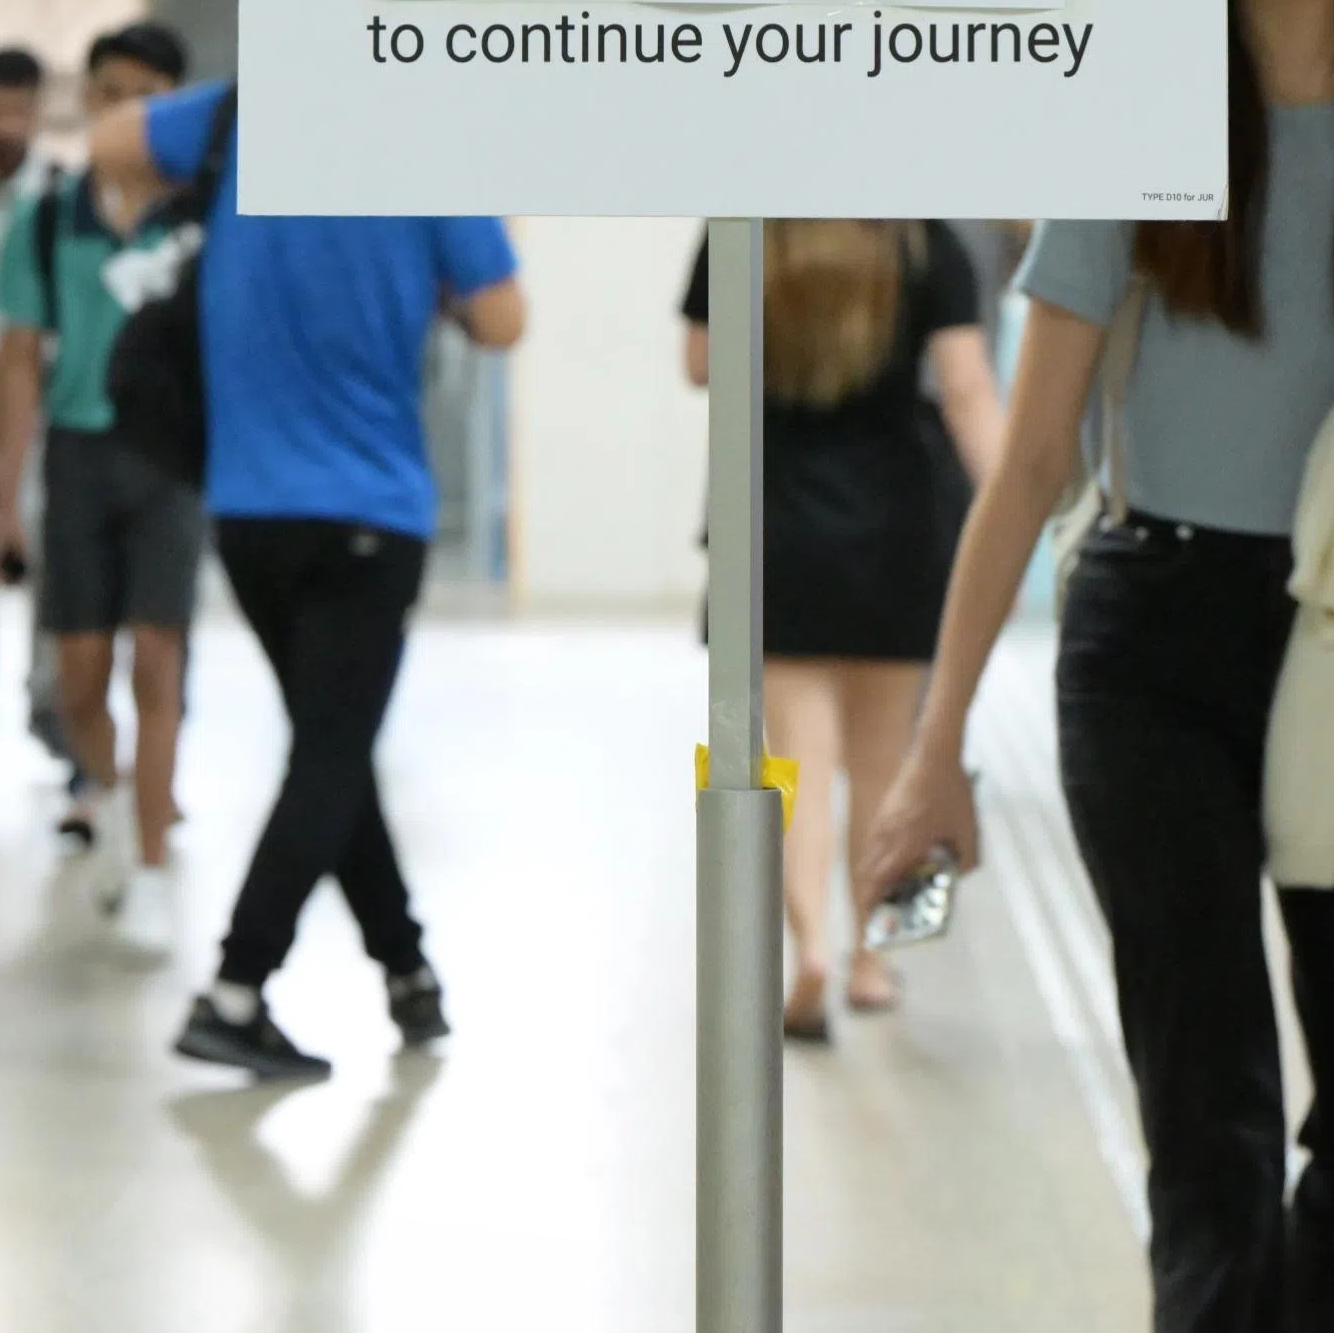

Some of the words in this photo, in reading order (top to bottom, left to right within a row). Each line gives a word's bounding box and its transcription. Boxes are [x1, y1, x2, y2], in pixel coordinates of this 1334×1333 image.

[366, 15, 424, 63] to
[445, 10, 703, 64] continue
[722, 23, 853, 78] your
[866, 10, 1094, 78] journey
[1142, 193, 1164, 202] TYPE
[1166, 193, 1182, 202] D10
[1183, 193, 1196, 202] for
[1197, 193, 1214, 202] JUR
